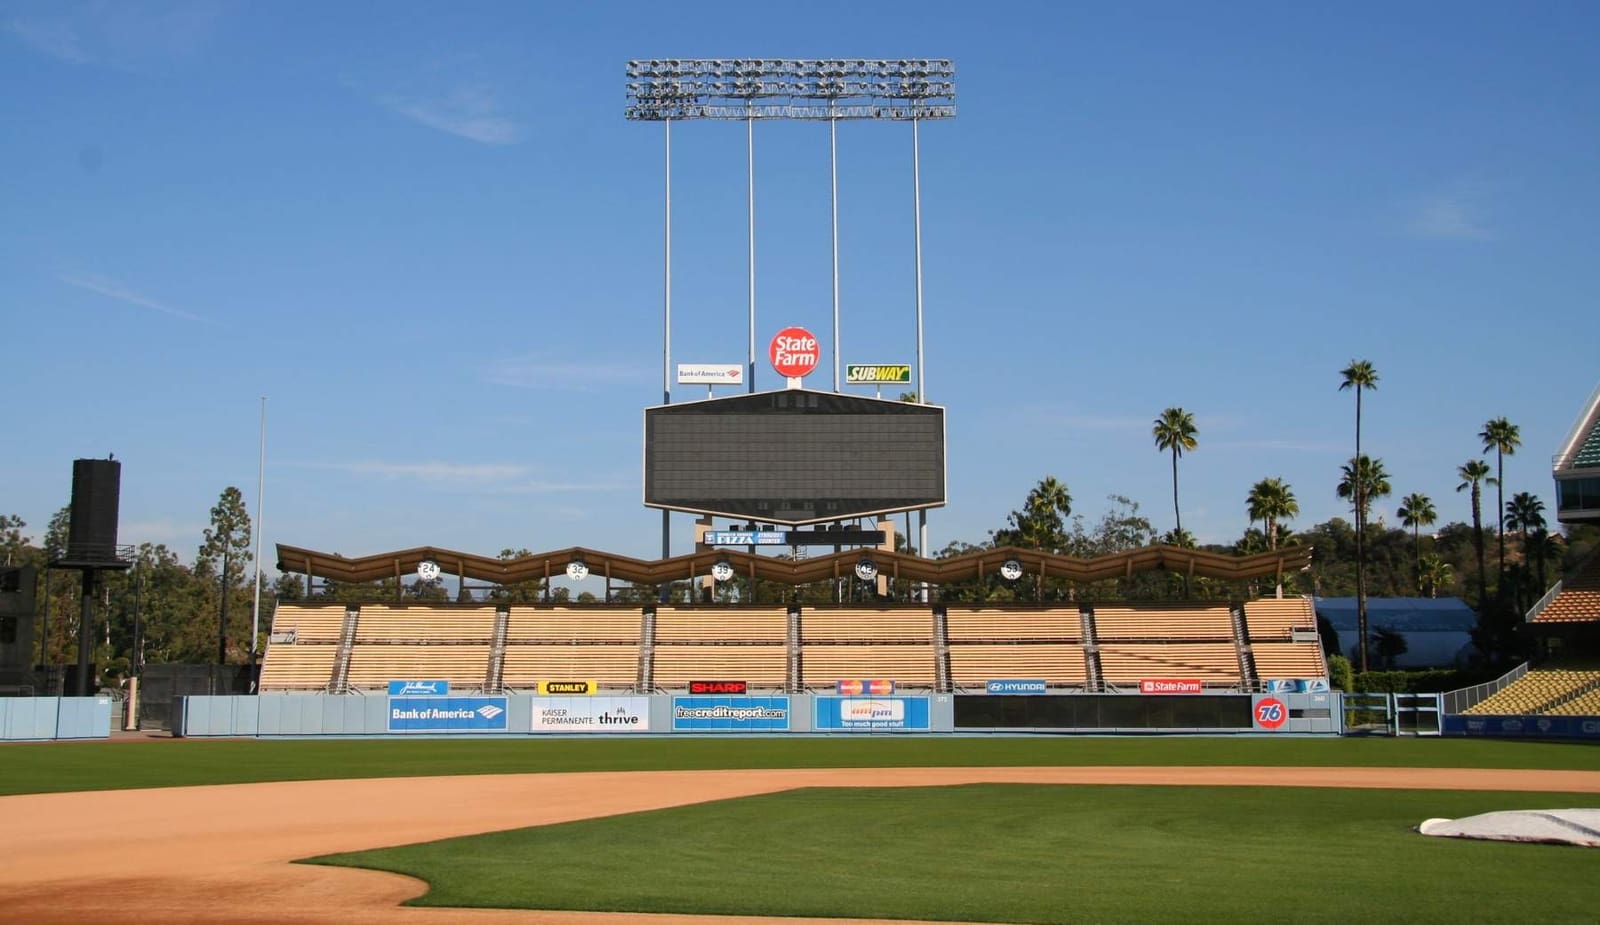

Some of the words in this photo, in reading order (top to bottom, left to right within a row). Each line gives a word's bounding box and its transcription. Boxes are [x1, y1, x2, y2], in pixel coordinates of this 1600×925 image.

[776, 336, 815, 351] State
[775, 352, 815, 366] Farm
[848, 366, 908, 381] SUBWAY
[717, 536, 754, 545] PIZZA
[423, 564, 435, 573] 24
[572, 564, 583, 573] 32
[717, 564, 728, 573] 39
[860, 564, 872, 574] 42
[1006, 564, 1018, 573] 53
[549, 684, 586, 692] STANLEY
[691, 683, 745, 693] SHARP
[1004, 683, 1045, 691] HYUNDAI
[1155, 682, 1177, 691] State
[1177, 682, 1199, 691] Farm
[392, 709, 419, 719] Bank
[420, 709, 431, 719] of
[432, 709, 475, 719] America
[542, 709, 567, 717] KAISER
[599, 711, 639, 724] thrive
[676, 706, 785, 720] freecreditreport.com
[1259, 704, 1281, 722] 76
[542, 717, 593, 725] PERMANENTE
